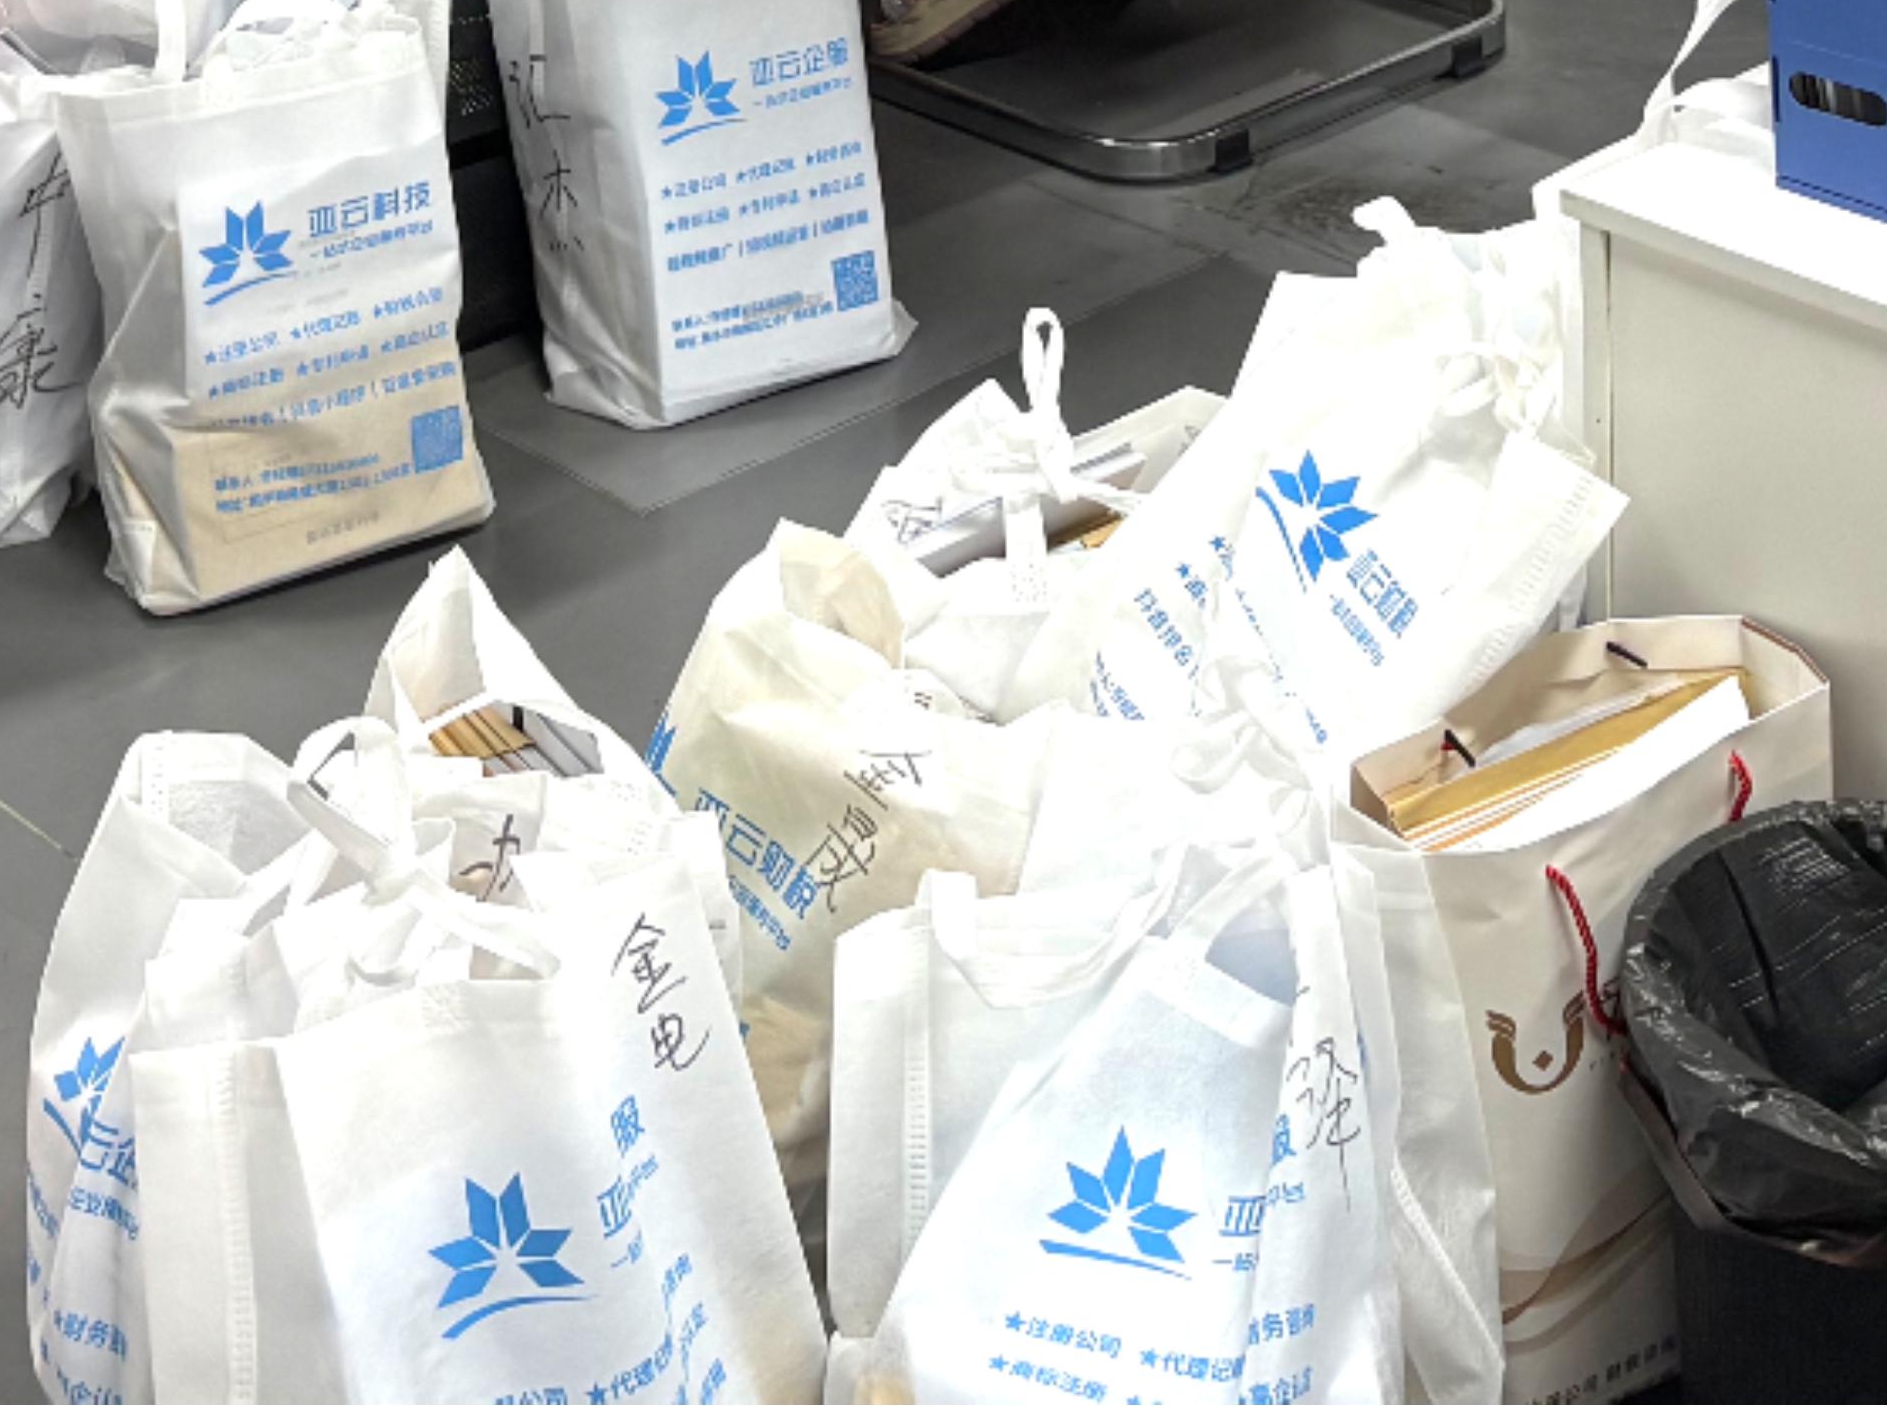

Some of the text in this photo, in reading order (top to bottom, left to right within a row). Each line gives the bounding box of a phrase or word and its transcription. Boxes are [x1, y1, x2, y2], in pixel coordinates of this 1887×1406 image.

[749, 37, 849, 87] 亚云企服
[307, 181, 432, 238] 亚云科技
[1025, 1315, 1123, 1360] 注册公司
[1008, 1358, 1108, 1404] 商标注册
